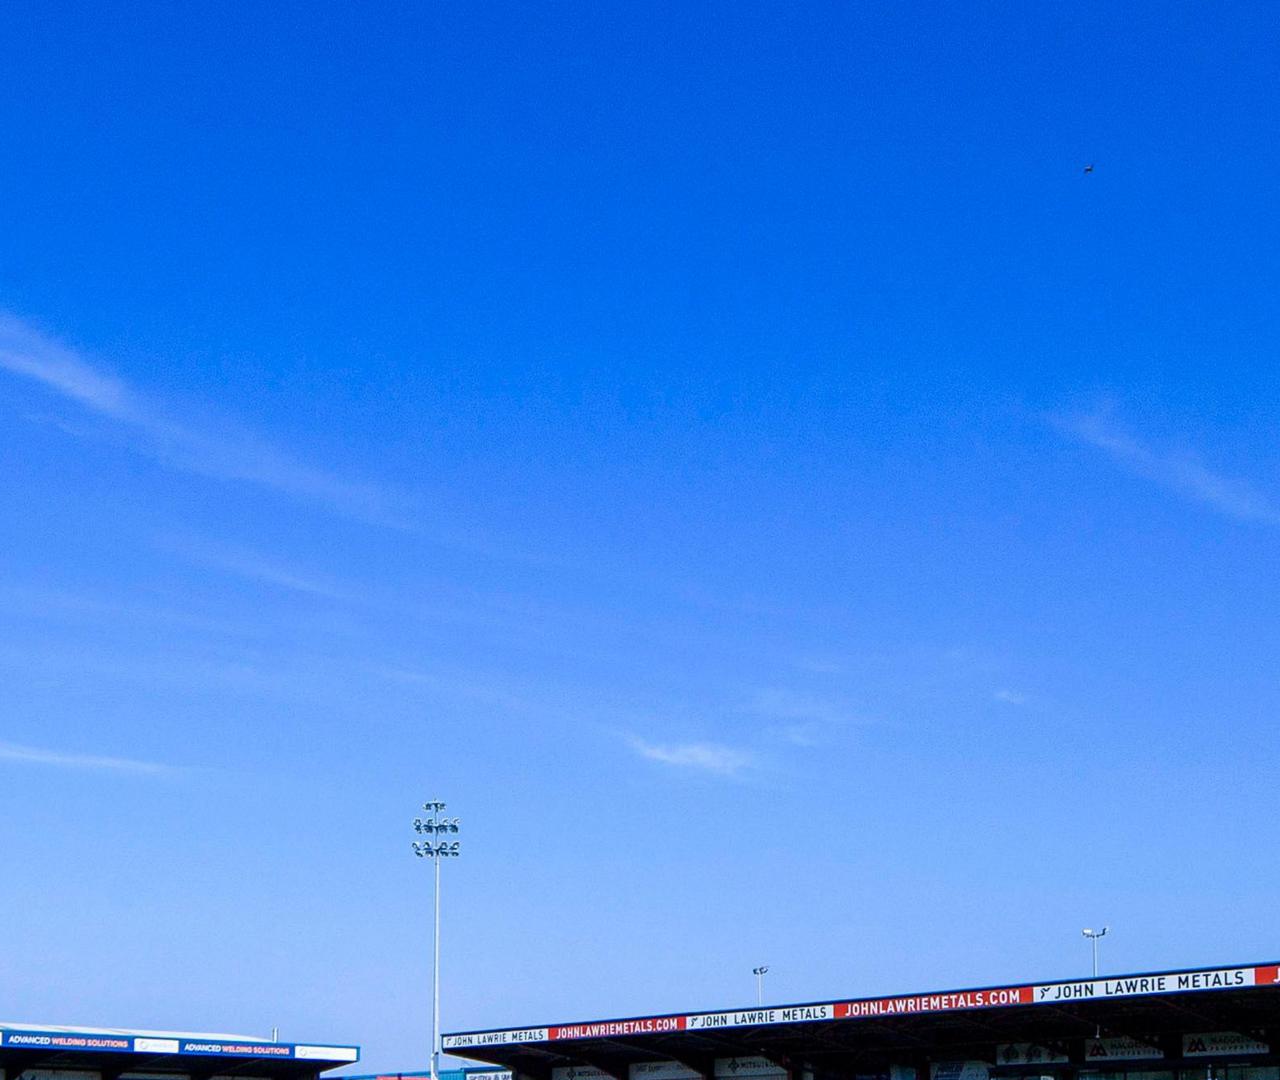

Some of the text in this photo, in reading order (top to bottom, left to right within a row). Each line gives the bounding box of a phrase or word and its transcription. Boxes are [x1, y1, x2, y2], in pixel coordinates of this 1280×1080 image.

[1055, 972, 1243, 999] JOHN LAWRIE METALS
[845, 990, 1020, 1016] JOHNLAWRIEMETALS.COM
[701, 1007, 826, 1027] JOHN LAWRIE METALS
[453, 1030, 544, 1046] JOHN LAWRIE METALS
[556, 1018, 678, 1039] JOHNLAWRIEMETALS.COM
[8, 1035, 129, 1048] ADVANCED WELDING SOLUTIONS
[184, 1043, 289, 1055] ADVANCED WELDING SOLUTIONS
